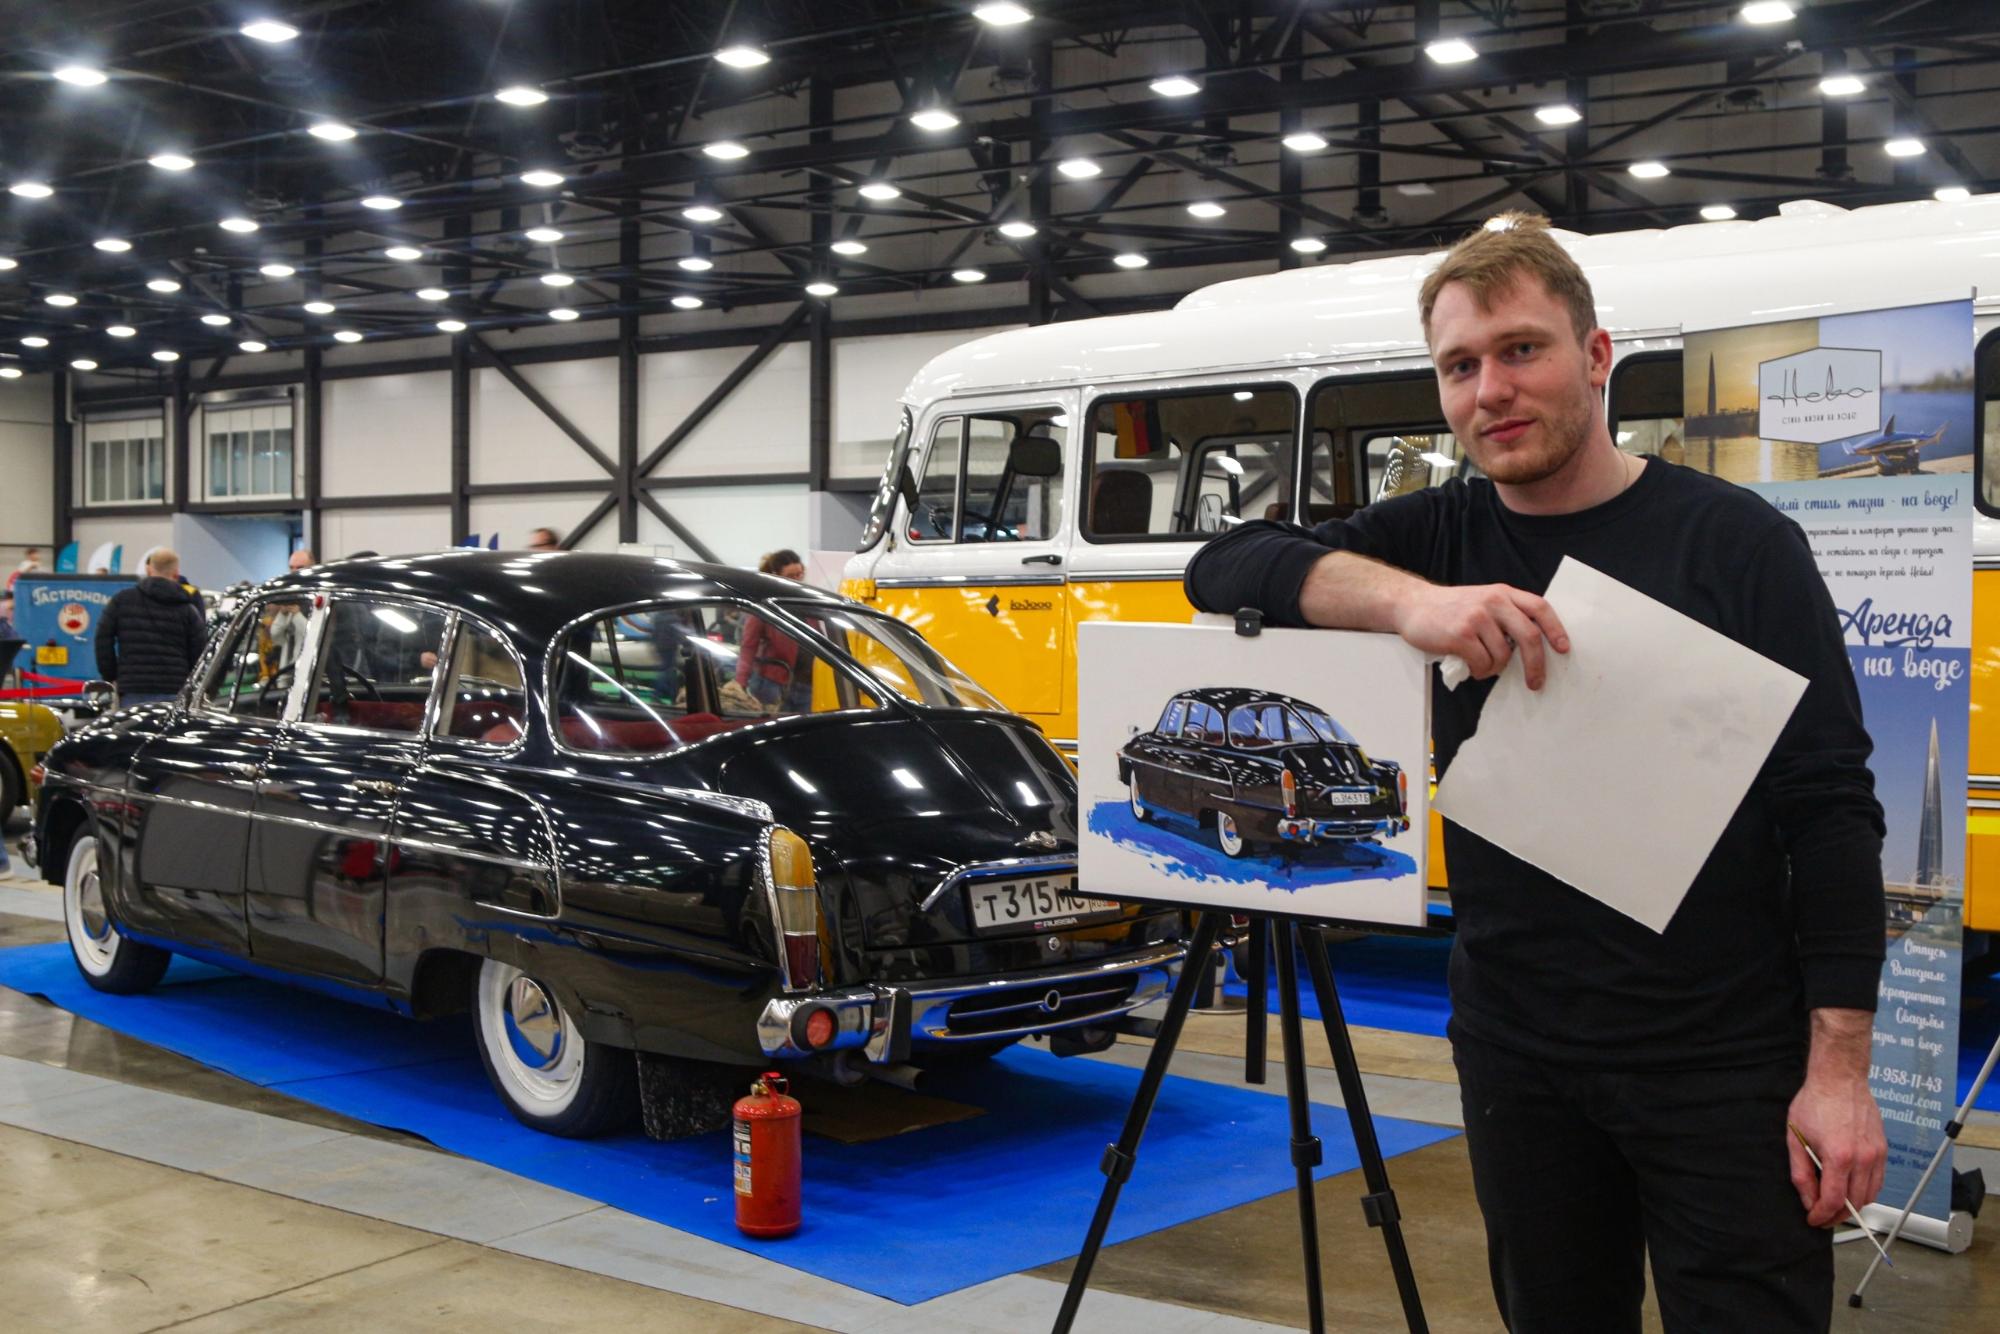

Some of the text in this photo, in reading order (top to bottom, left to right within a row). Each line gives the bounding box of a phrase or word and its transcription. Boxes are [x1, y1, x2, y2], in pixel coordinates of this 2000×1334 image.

[1771, 496, 1799, 511] вый
[1804, 499, 1841, 510] стиль
[1847, 498, 1884, 514] жизни
[1901, 495, 1918, 507] на
[1923, 488, 1958, 512] воде!
[1836, 598, 1952, 652] Аренда
[1863, 647, 1964, 691] на воде
[1904, 938, 1946, 962] Отпуск
[1868, 1063, 1943, 1093] 31-958-11-43
[1870, 1087, 1941, 1112] useboat.com
